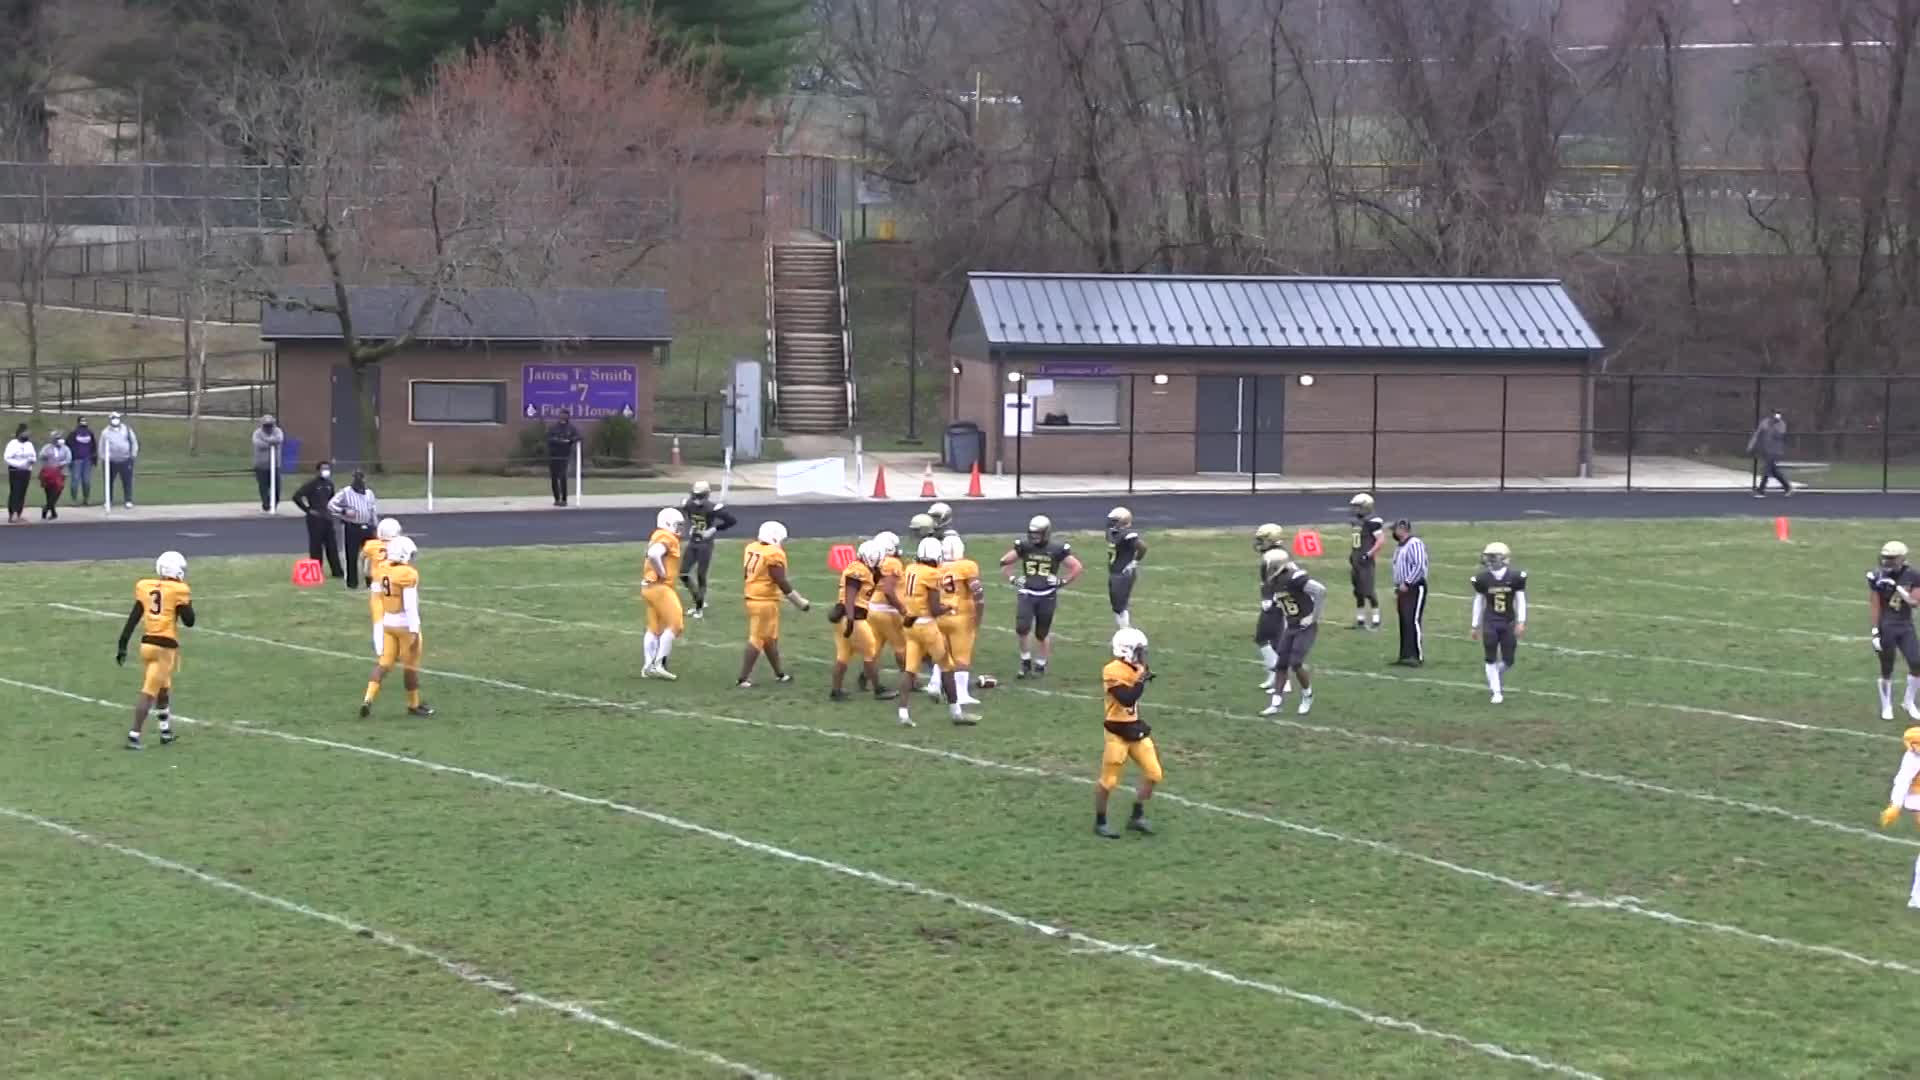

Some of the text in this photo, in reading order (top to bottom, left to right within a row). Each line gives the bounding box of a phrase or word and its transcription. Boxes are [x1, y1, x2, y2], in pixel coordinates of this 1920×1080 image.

[527, 367, 632, 383] James T. Smith
[578, 403, 619, 417] House
[1303, 535, 1316, 552] G
[299, 562, 321, 582] 20
[906, 572, 917, 597] 11
[149, 589, 162, 616] 3
[1494, 592, 1506, 613] 6
[1888, 591, 1902, 612] 4
